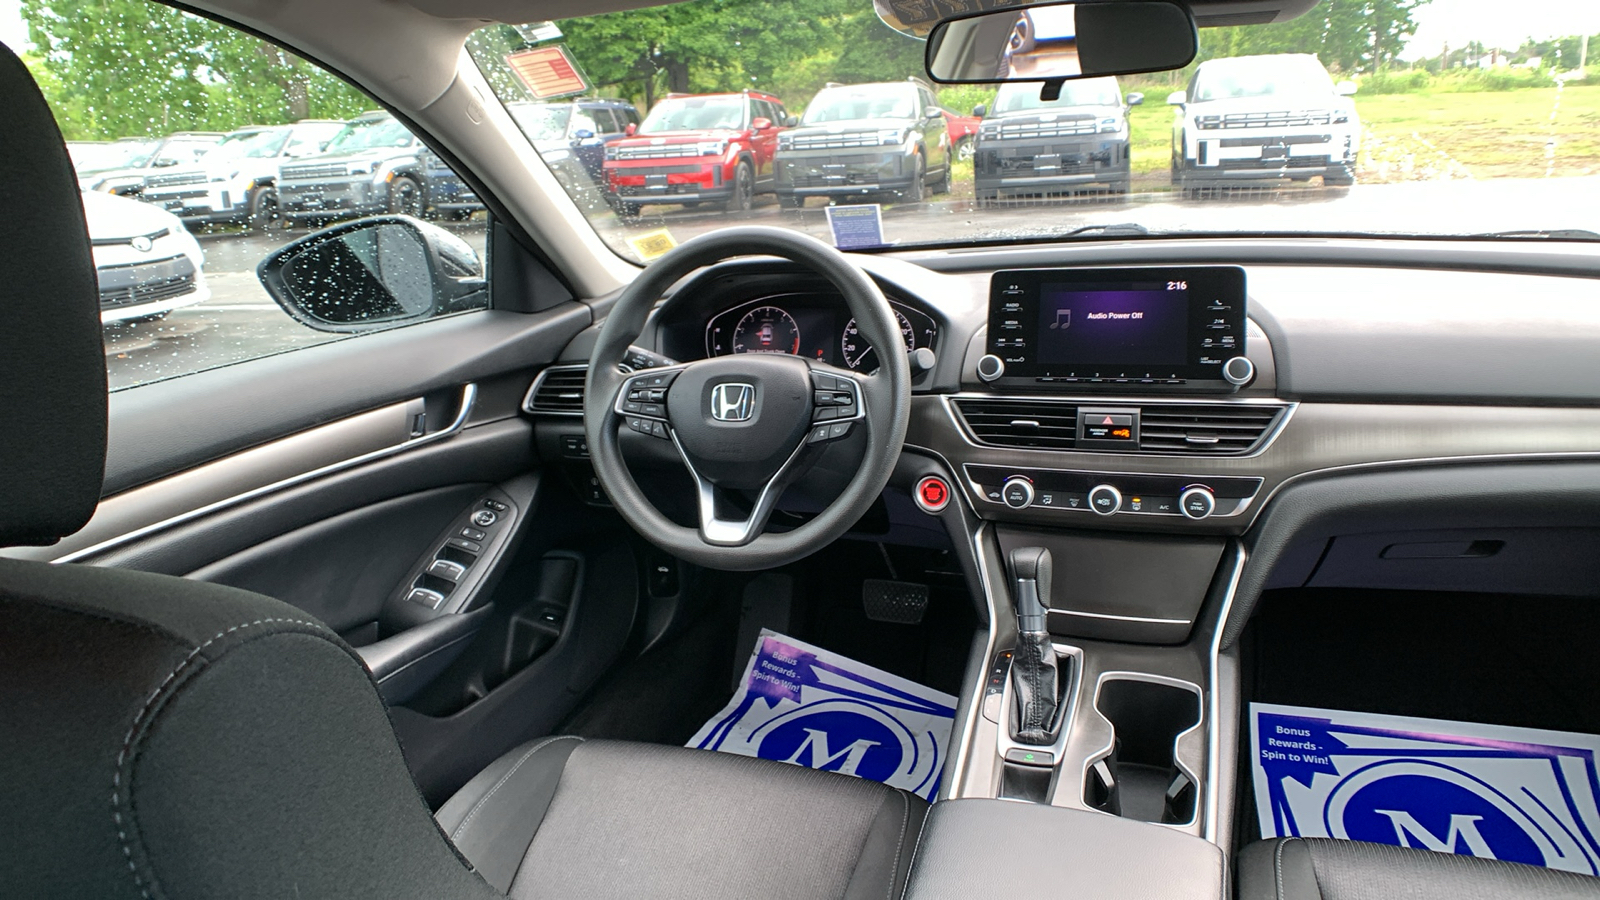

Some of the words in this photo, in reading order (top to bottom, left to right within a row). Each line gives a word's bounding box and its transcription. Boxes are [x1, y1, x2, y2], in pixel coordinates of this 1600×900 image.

[1166, 281, 1187, 290] 2:16
[817, 349, 823, 357] P
[772, 651, 798, 666] Bonus
[761, 660, 797, 679] Rewards
[752, 669, 770, 682] Spin
[770, 675, 780, 685] to
[781, 679, 800, 693] Win!
[1275, 725, 1311, 737] Bonus
[1268, 737, 1317, 751] Rewards
[777, 727, 882, 778] M
[1261, 749, 1286, 760] Spin
[1288, 753, 1301, 762] to
[1302, 754, 1329, 765] Win!
[1374, 808, 1498, 861] M
